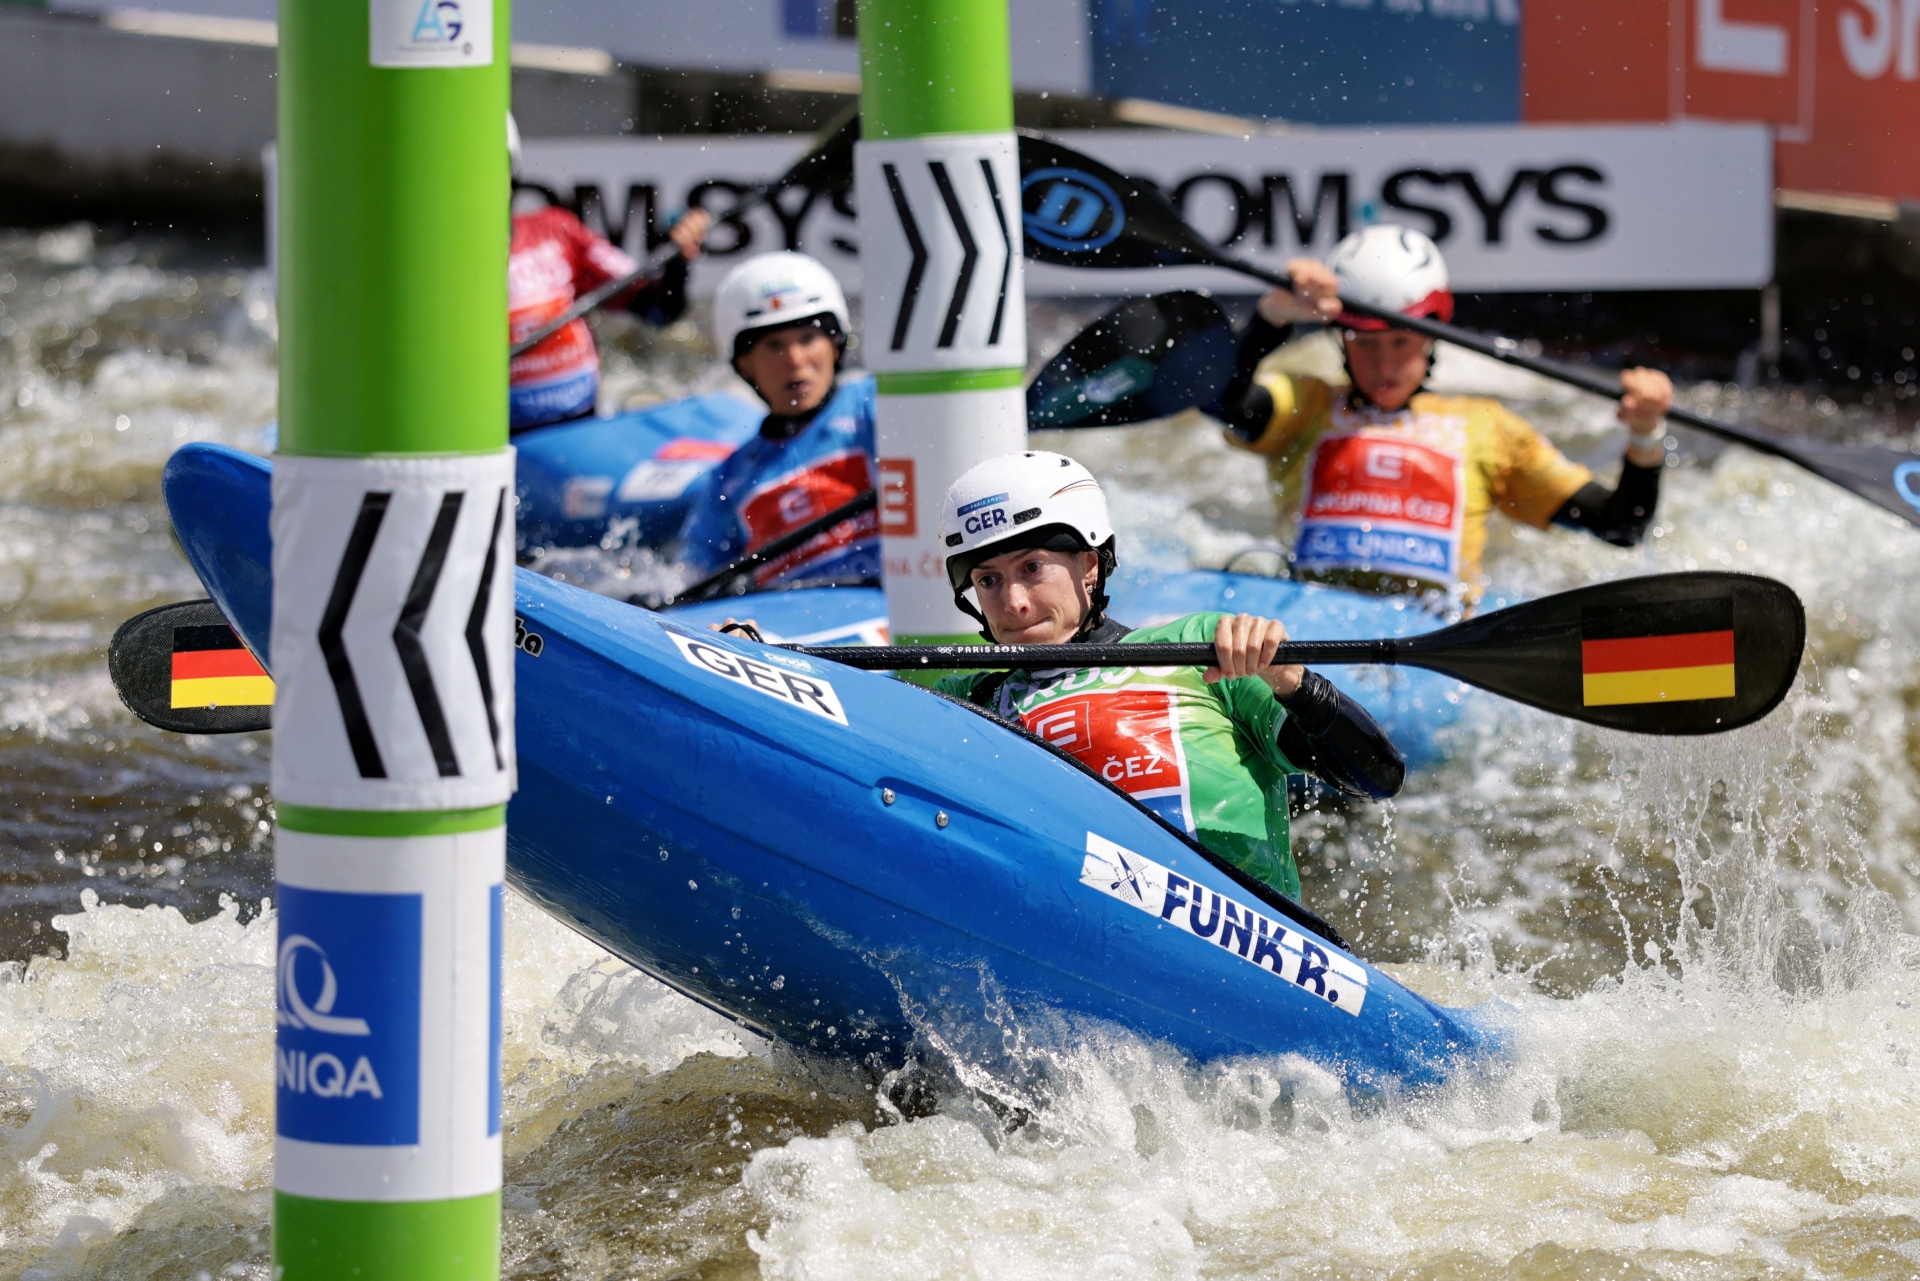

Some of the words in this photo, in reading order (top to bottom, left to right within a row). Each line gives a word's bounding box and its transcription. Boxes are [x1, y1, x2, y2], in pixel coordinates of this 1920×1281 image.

[965, 508, 1008, 534] GER
[957, 646, 991, 654] PARIS
[994, 645, 1025, 654] 2024
[687, 642, 837, 717] GER
[1102, 754, 1164, 783] ČEZ
[1161, 871, 1288, 975] FUNK
[1295, 939, 1339, 1003] R.
[276, 1046, 384, 1099] NIQA
